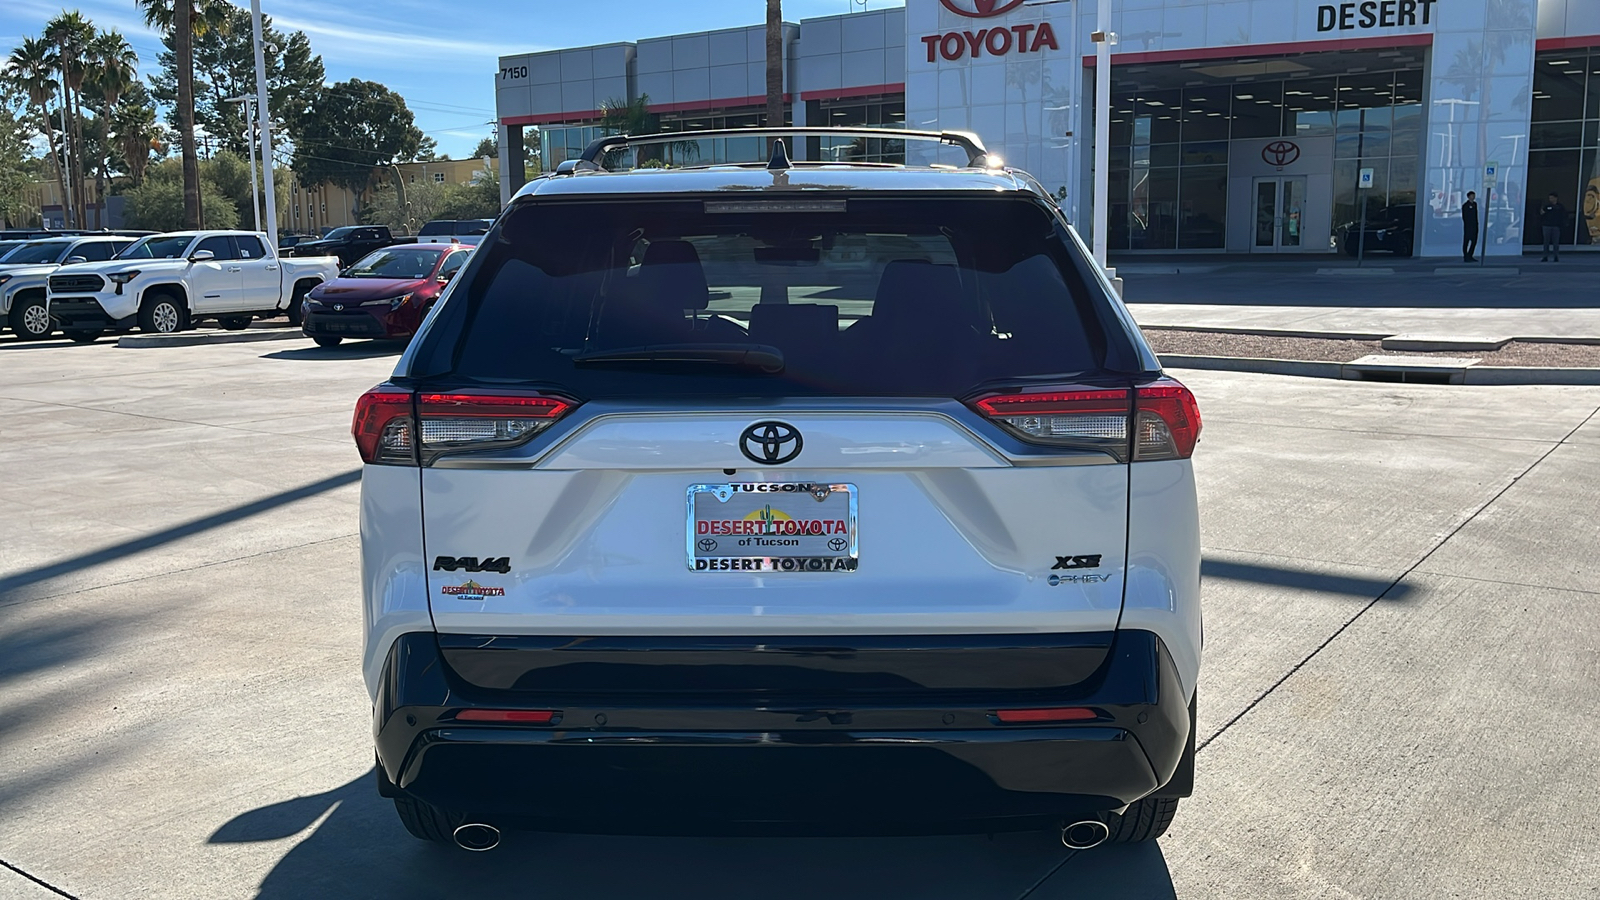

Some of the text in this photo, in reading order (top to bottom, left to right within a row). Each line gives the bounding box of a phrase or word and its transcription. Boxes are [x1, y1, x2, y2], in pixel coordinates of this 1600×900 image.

[1317, 0, 1437, 32] DESERT
[921, 22, 1059, 63] TOYOTA
[501, 66, 528, 80] 7150
[731, 483, 811, 492] TUCSON
[697, 520, 847, 535] DESERT TOYOTA
[738, 537, 799, 547] of Tucson
[433, 556, 511, 574] RAV4
[696, 558, 846, 571] DESERT TOYOTA
